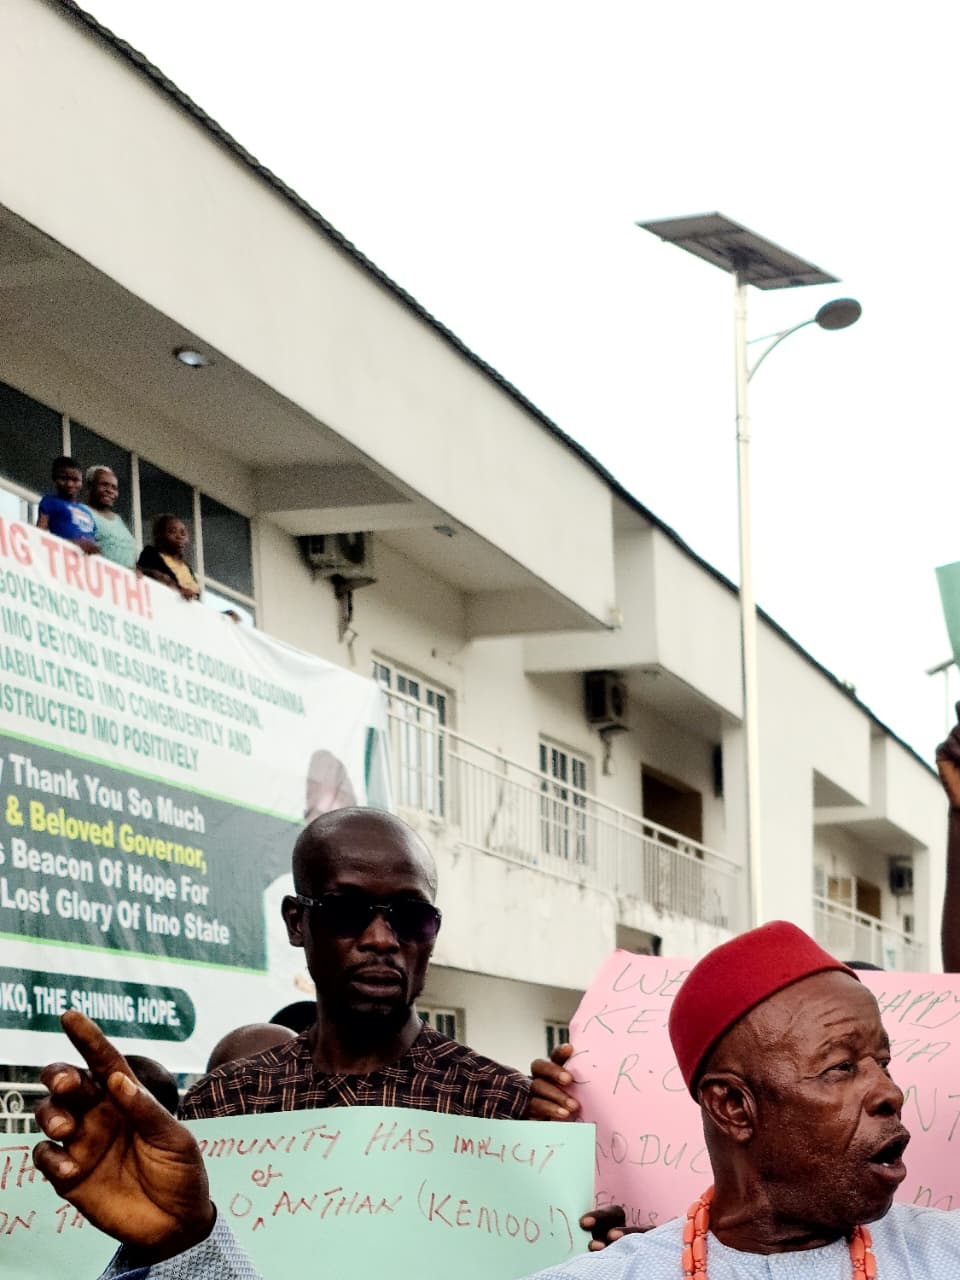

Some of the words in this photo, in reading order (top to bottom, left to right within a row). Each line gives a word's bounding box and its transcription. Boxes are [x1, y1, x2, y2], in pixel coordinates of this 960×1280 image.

[41, 536, 153, 621] TRUTH!
[1, 605, 32, 642] IMO
[36, 620, 98, 667] BEYOND
[102, 647, 170, 694] MEASURE
[174, 674, 182, 699] &
[158, 634, 194, 671] HOPE
[92, 713, 119, 746] IMO
[123, 724, 198, 772] POSITIVELY
[98, 680, 125, 712] IMO
[129, 692, 223, 747] CONGRUENTLY
[228, 728, 252, 757] AND
[8, 753, 80, 801] Thank
[84, 774, 123, 812] You
[127, 787, 153, 820] So
[157, 795, 206, 834] Much
[6, 795, 24, 826] &
[30, 800, 115, 849] Beloved
[119, 823, 207, 875] Governor,
[11, 837, 93, 883] Beacon
[99, 857, 123, 888] Of
[128, 863, 177, 903] Hope
[180, 875, 209, 906] For
[1, 877, 50, 916] Lost
[56, 888, 112, 932] Glory
[117, 900, 140, 930] Of
[145, 904, 180, 936] Imo
[184, 912, 230, 945] State
[34, 985, 67, 1016] THE
[70, 989, 135, 1022] SHINING
[364, 1121, 435, 1156] HAS
